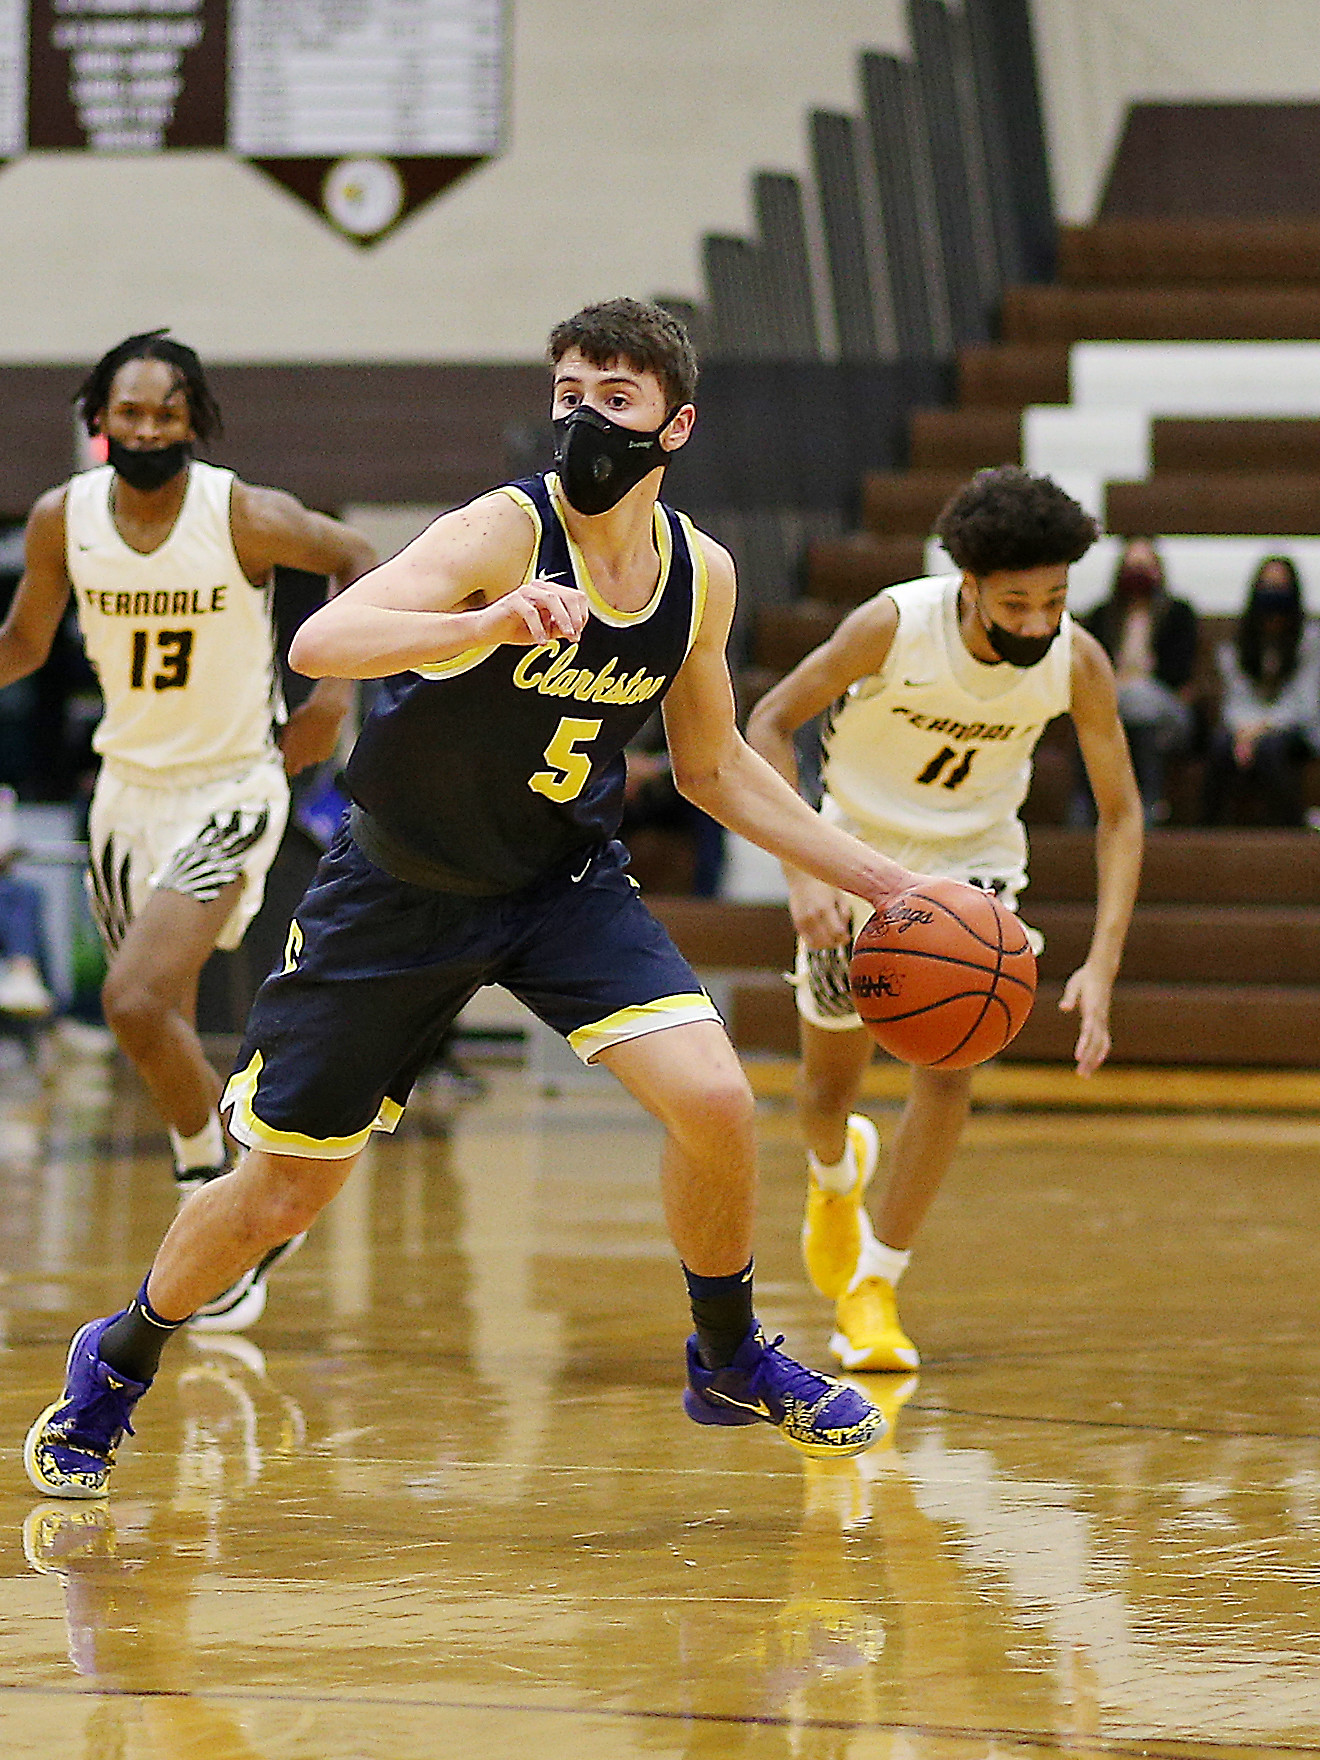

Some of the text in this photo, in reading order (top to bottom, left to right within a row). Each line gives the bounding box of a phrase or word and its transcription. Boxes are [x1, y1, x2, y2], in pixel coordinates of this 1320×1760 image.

[84, 584, 229, 617] FERNDALE
[130, 628, 194, 692] 13
[891, 706, 1040, 741] ERNDAL
[527, 716, 604, 804] 5
[914, 745, 980, 790] 11
